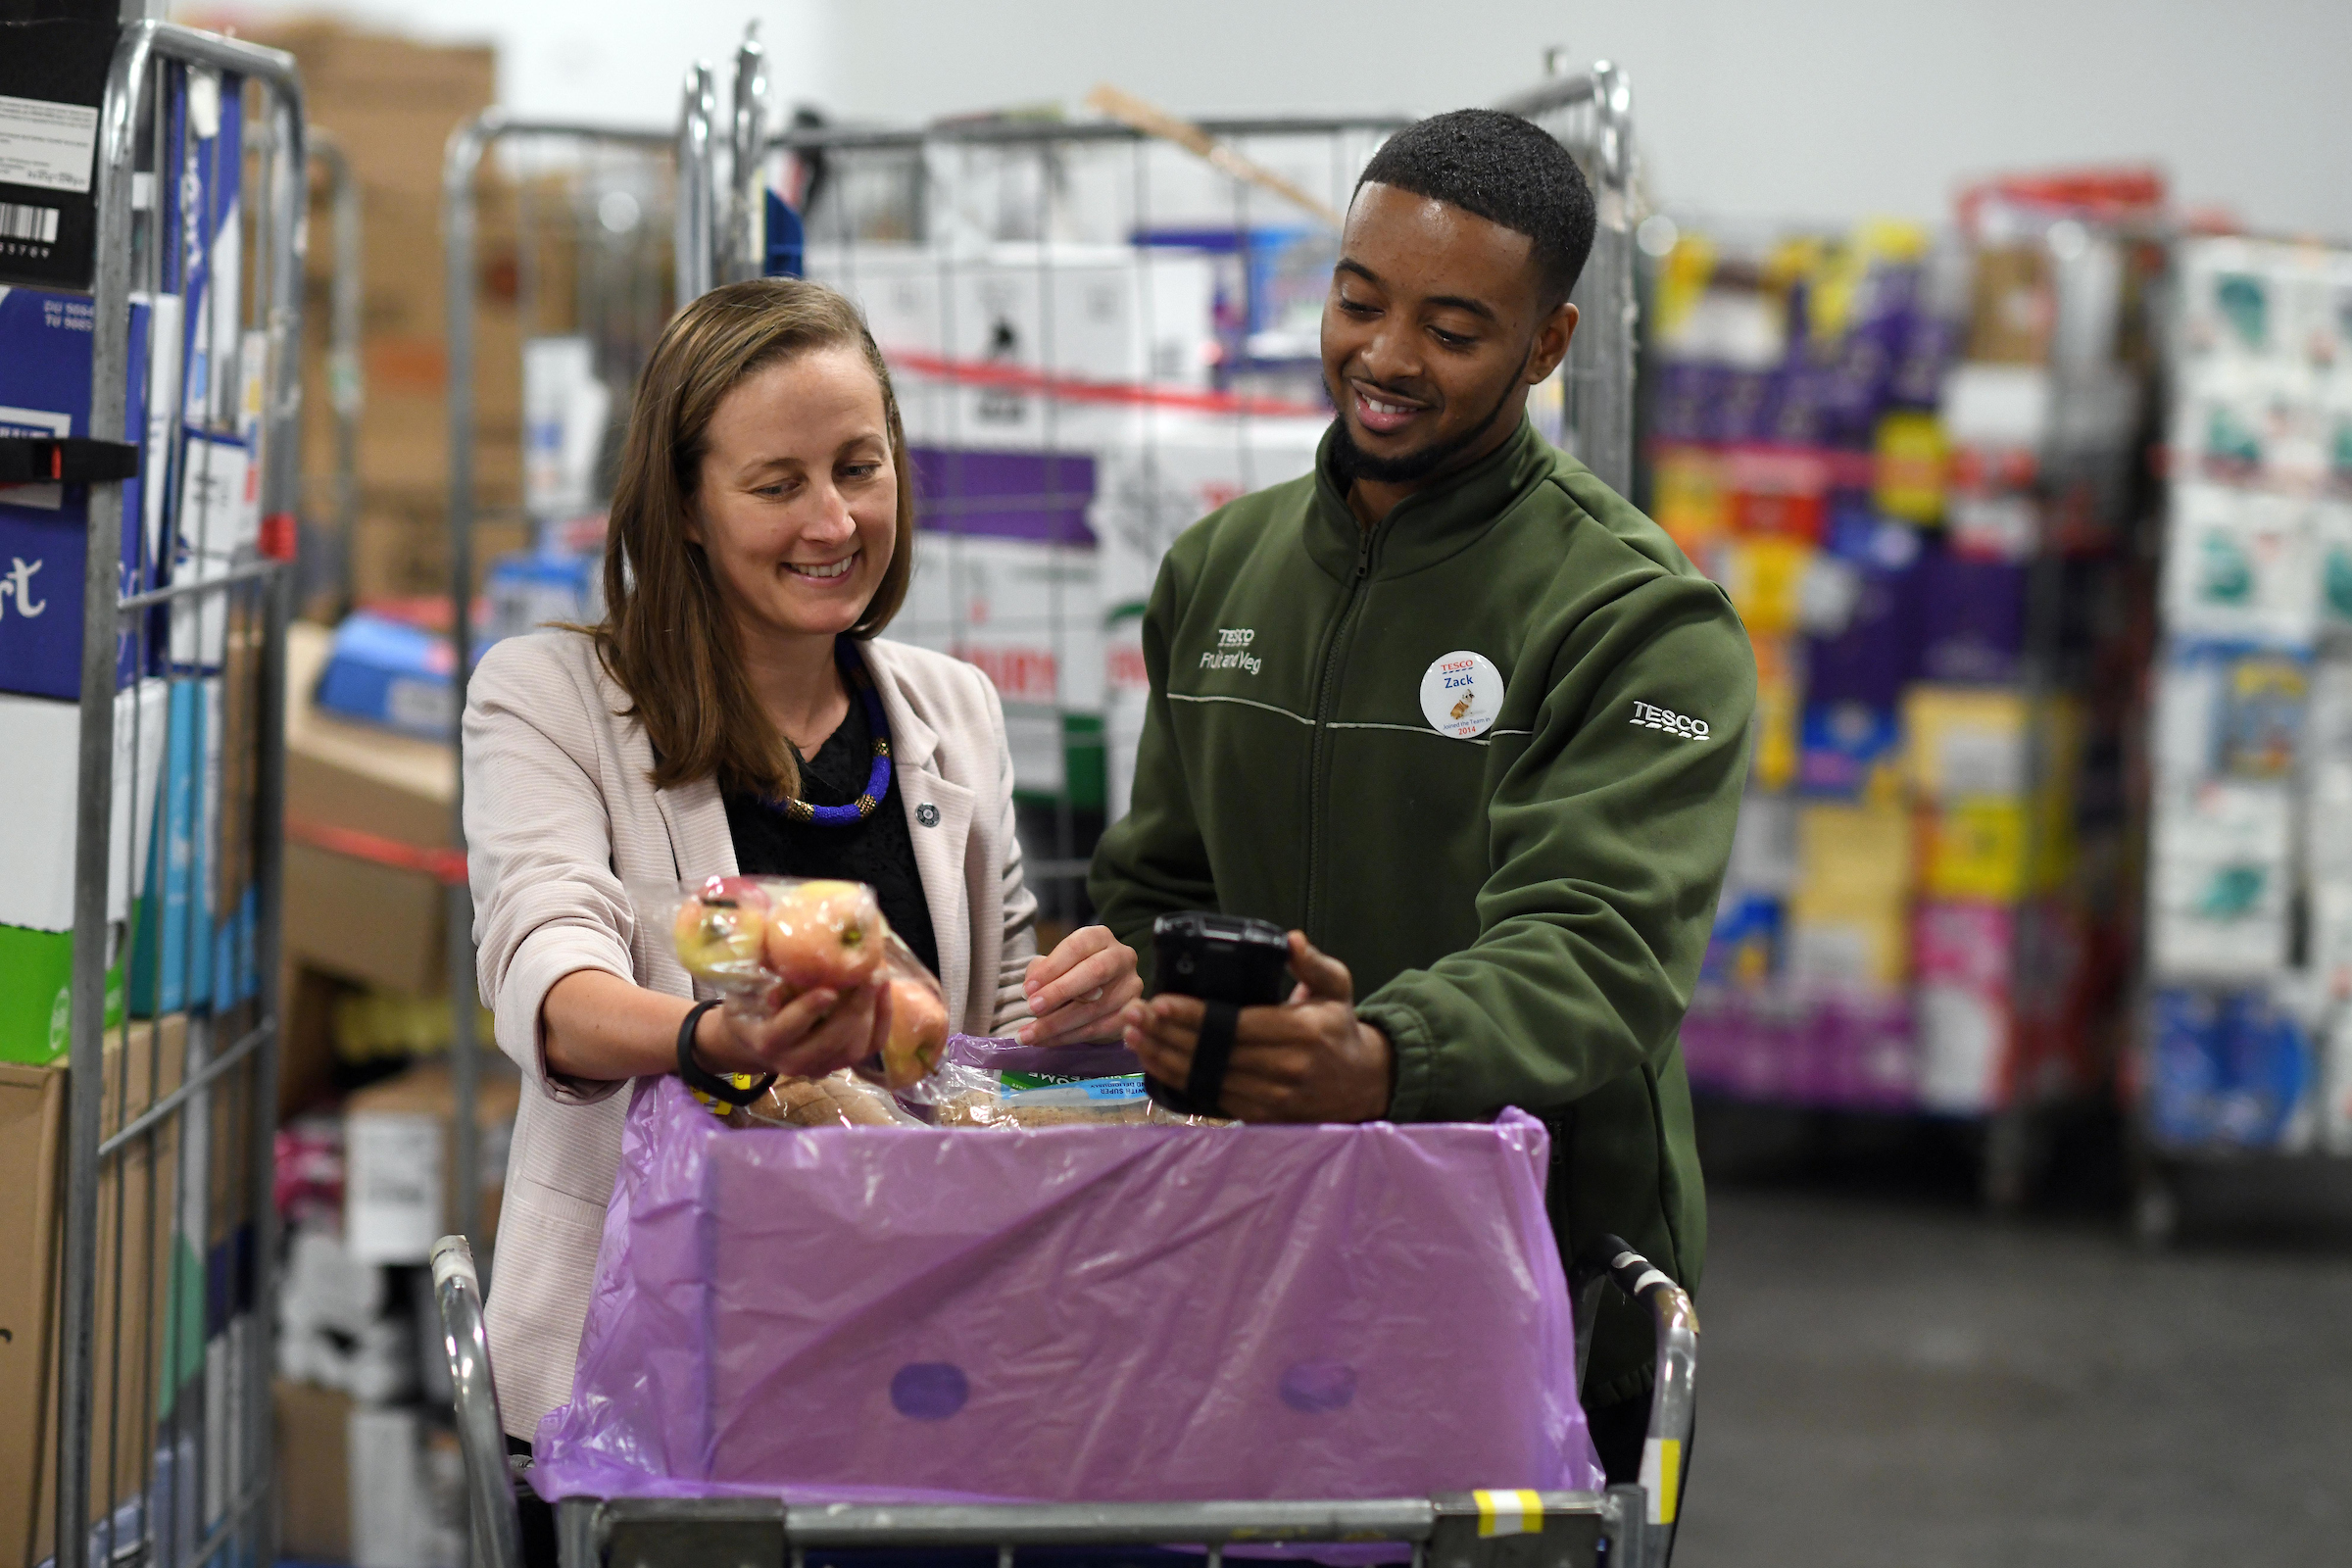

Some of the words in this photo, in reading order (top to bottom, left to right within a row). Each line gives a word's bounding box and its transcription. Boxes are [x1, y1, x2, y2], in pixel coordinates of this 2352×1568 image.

[1218, 628, 1254, 644] TESCO
[1200, 650, 1224, 669] Fruit
[1222, 651, 1240, 667] and
[1239, 651, 1262, 676] Veg
[1441, 660, 1473, 671] TESCO
[1444, 674, 1474, 689] Zack
[1633, 701, 1709, 736] TESCO
[1458, 726, 1476, 735] 2014
